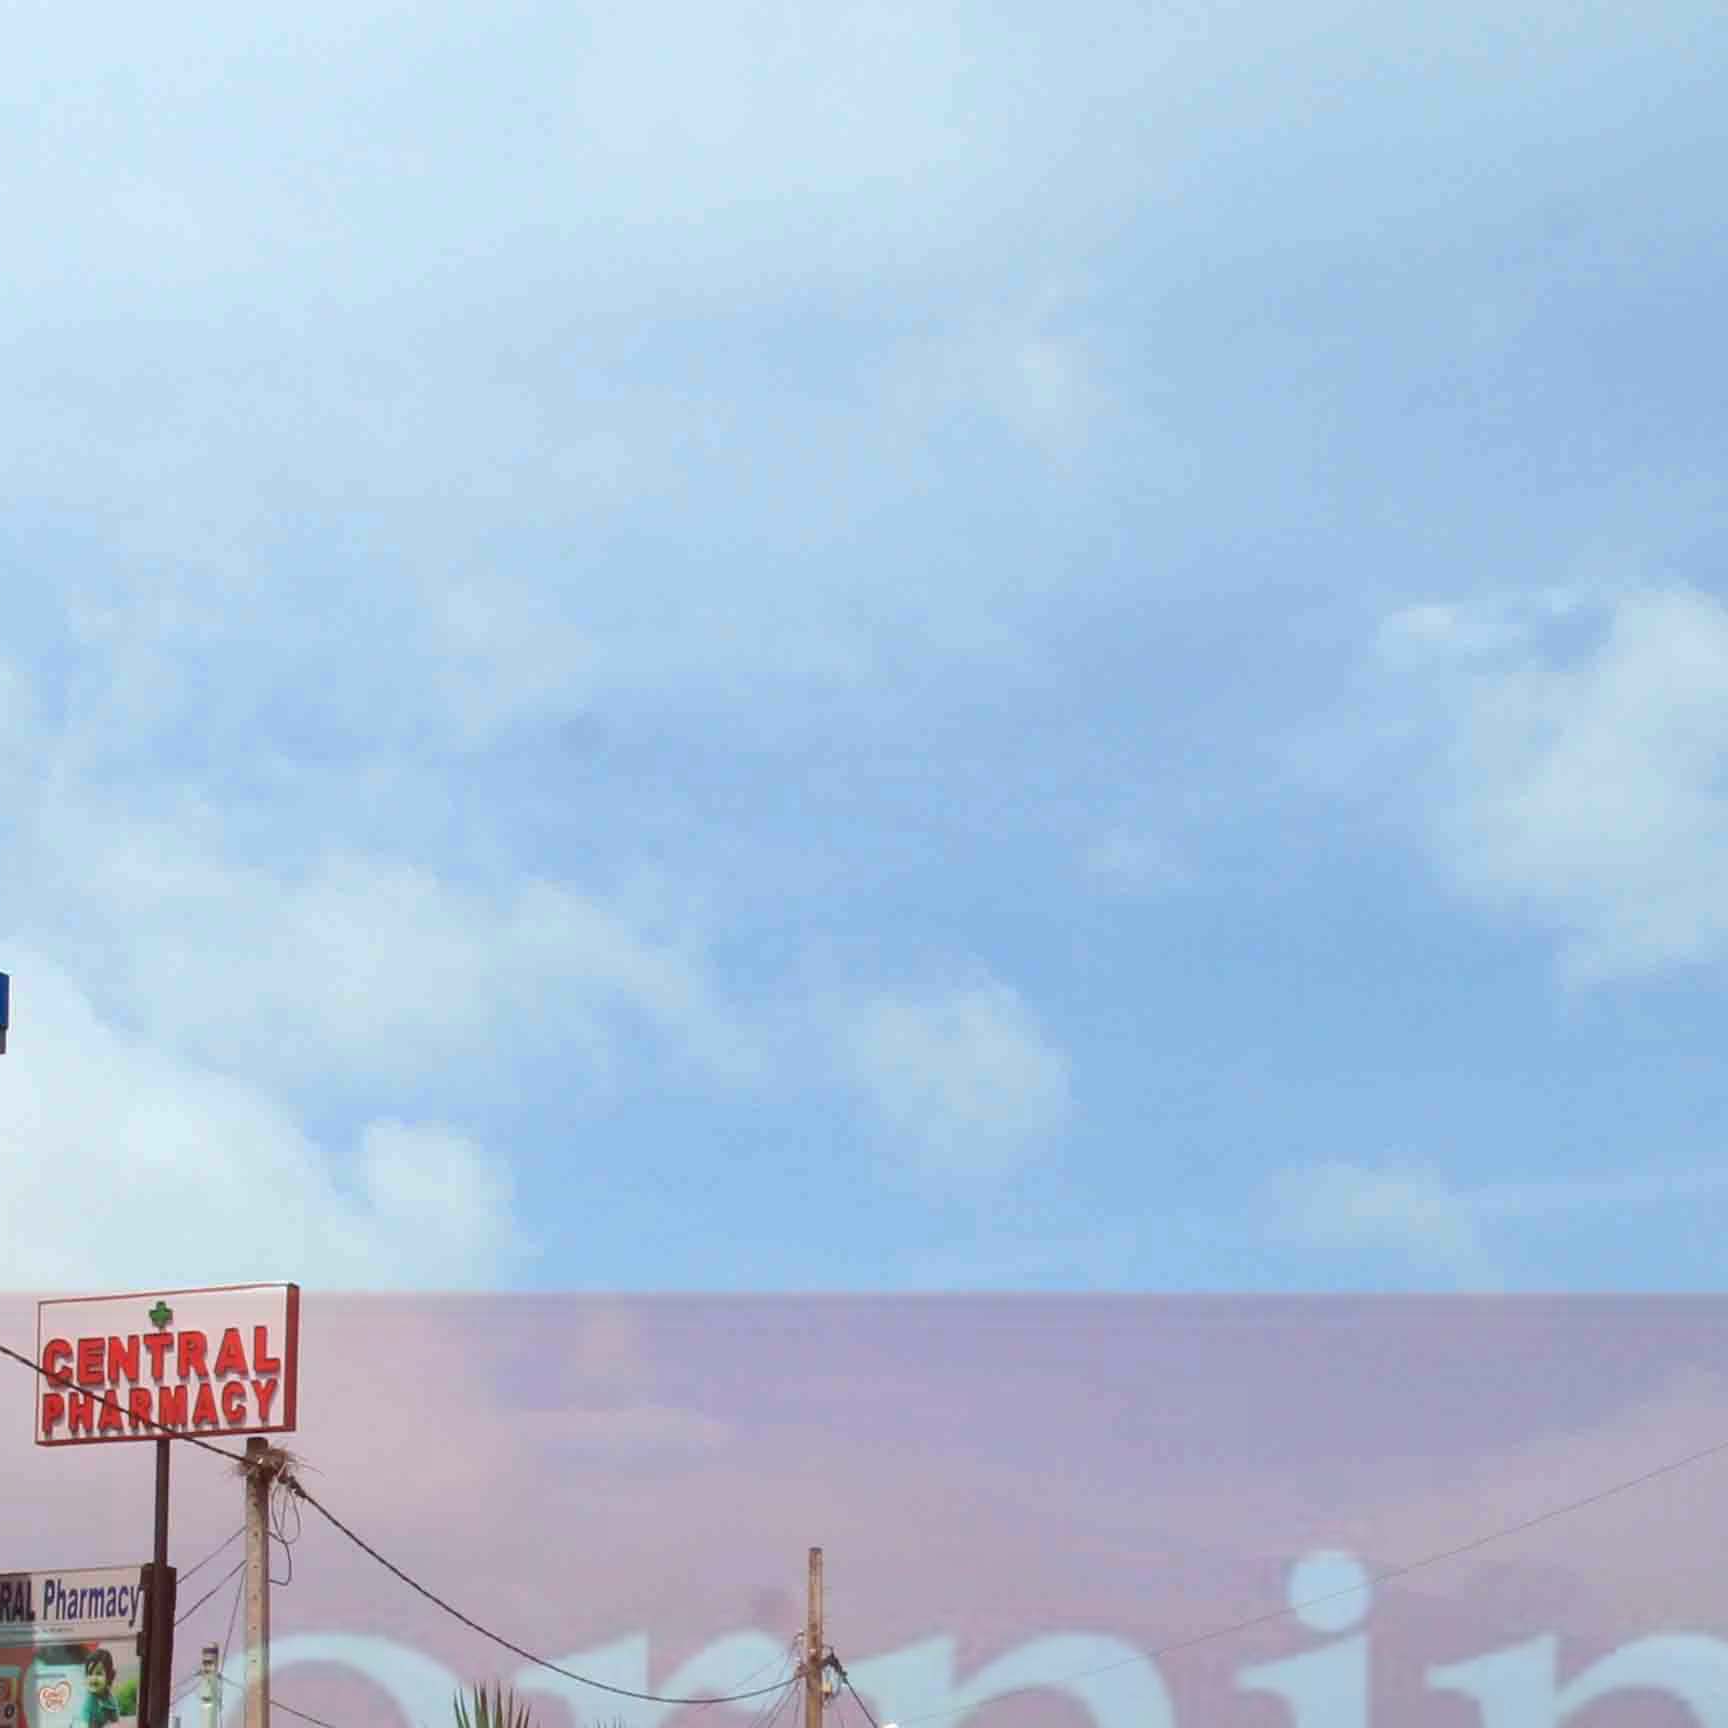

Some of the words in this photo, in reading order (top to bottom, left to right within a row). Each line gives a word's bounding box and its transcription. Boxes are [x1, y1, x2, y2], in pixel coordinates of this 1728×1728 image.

[43, 1325, 281, 1388] CENTRAL
[41, 1378, 278, 1438] PHARMACY
[42, 1578, 145, 1628] Pharmacy
